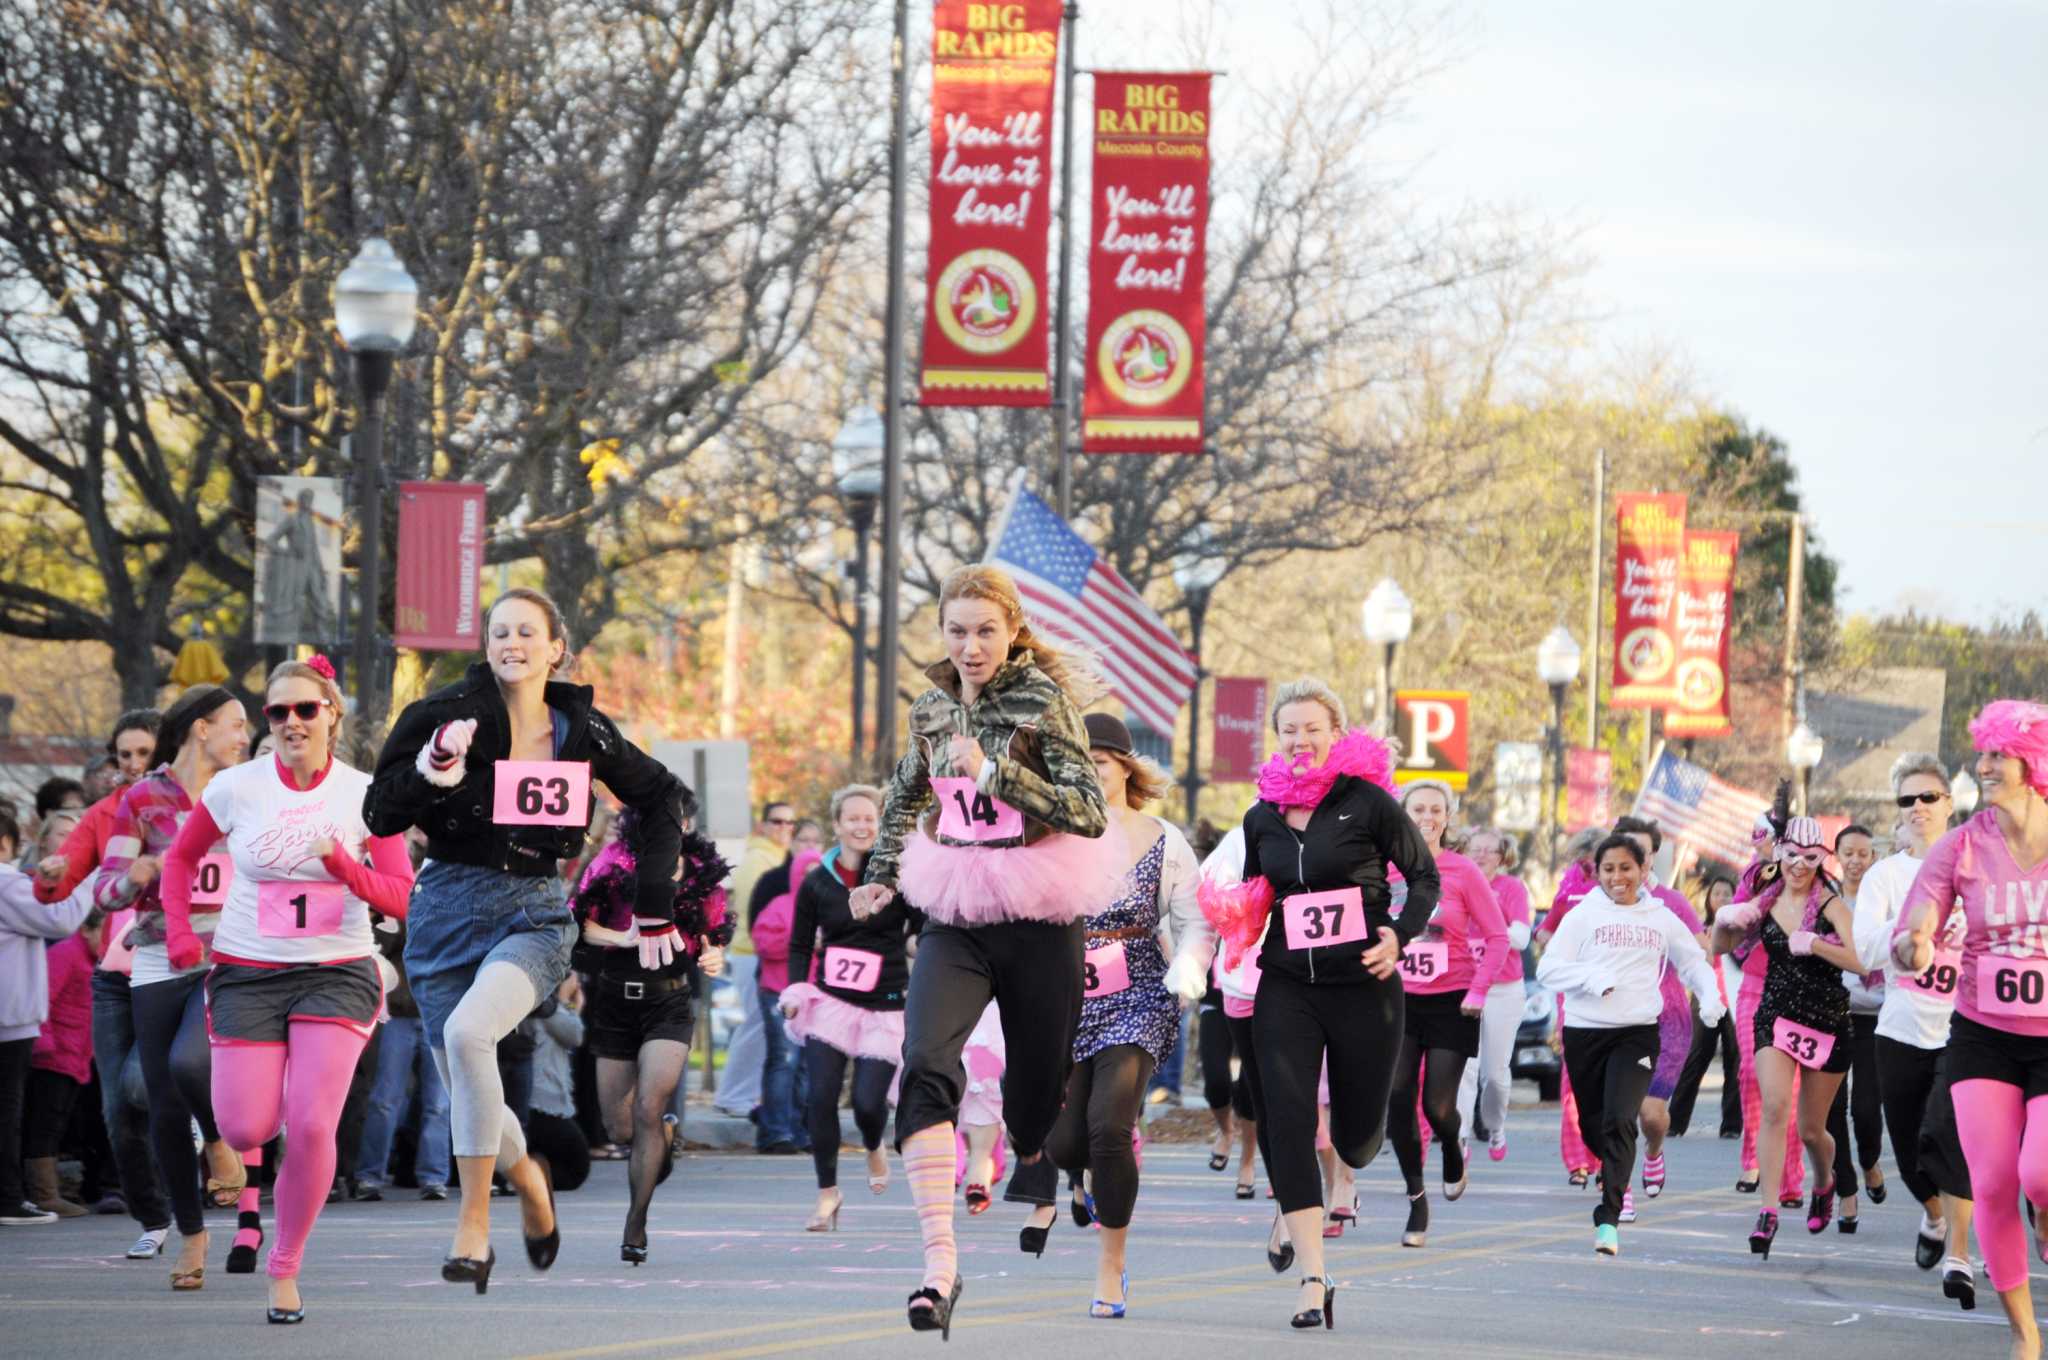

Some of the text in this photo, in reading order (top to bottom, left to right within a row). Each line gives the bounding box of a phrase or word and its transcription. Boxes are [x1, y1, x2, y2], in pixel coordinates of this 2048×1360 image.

[967, 4, 1025, 30] BIG
[936, 30, 1056, 57] RAPIDS
[1001, 65, 1051, 85] County
[1125, 84, 1178, 108] BIG
[944, 111, 1042, 148] You'll
[1098, 109, 1205, 134] RAPIDS
[938, 148, 1040, 186] love it
[1097, 141, 1201, 159] Mecosta County
[953, 187, 1031, 229] here!
[1105, 185, 1195, 218] You'll
[1100, 218, 1195, 253] love it
[1115, 255, 1187, 291] here!
[1405, 700, 1456, 768] P
[516, 776, 570, 815] 63
[952, 788, 999, 827] 14
[289, 893, 307, 929] 1
[1302, 903, 1345, 940] 37
[1594, 923, 1664, 948] FERRIS STATE
[836, 958, 867, 983] 27
[1403, 952, 1435, 977] 45
[1995, 968, 2044, 1005] 60
[1785, 1031, 1818, 1061] 33
